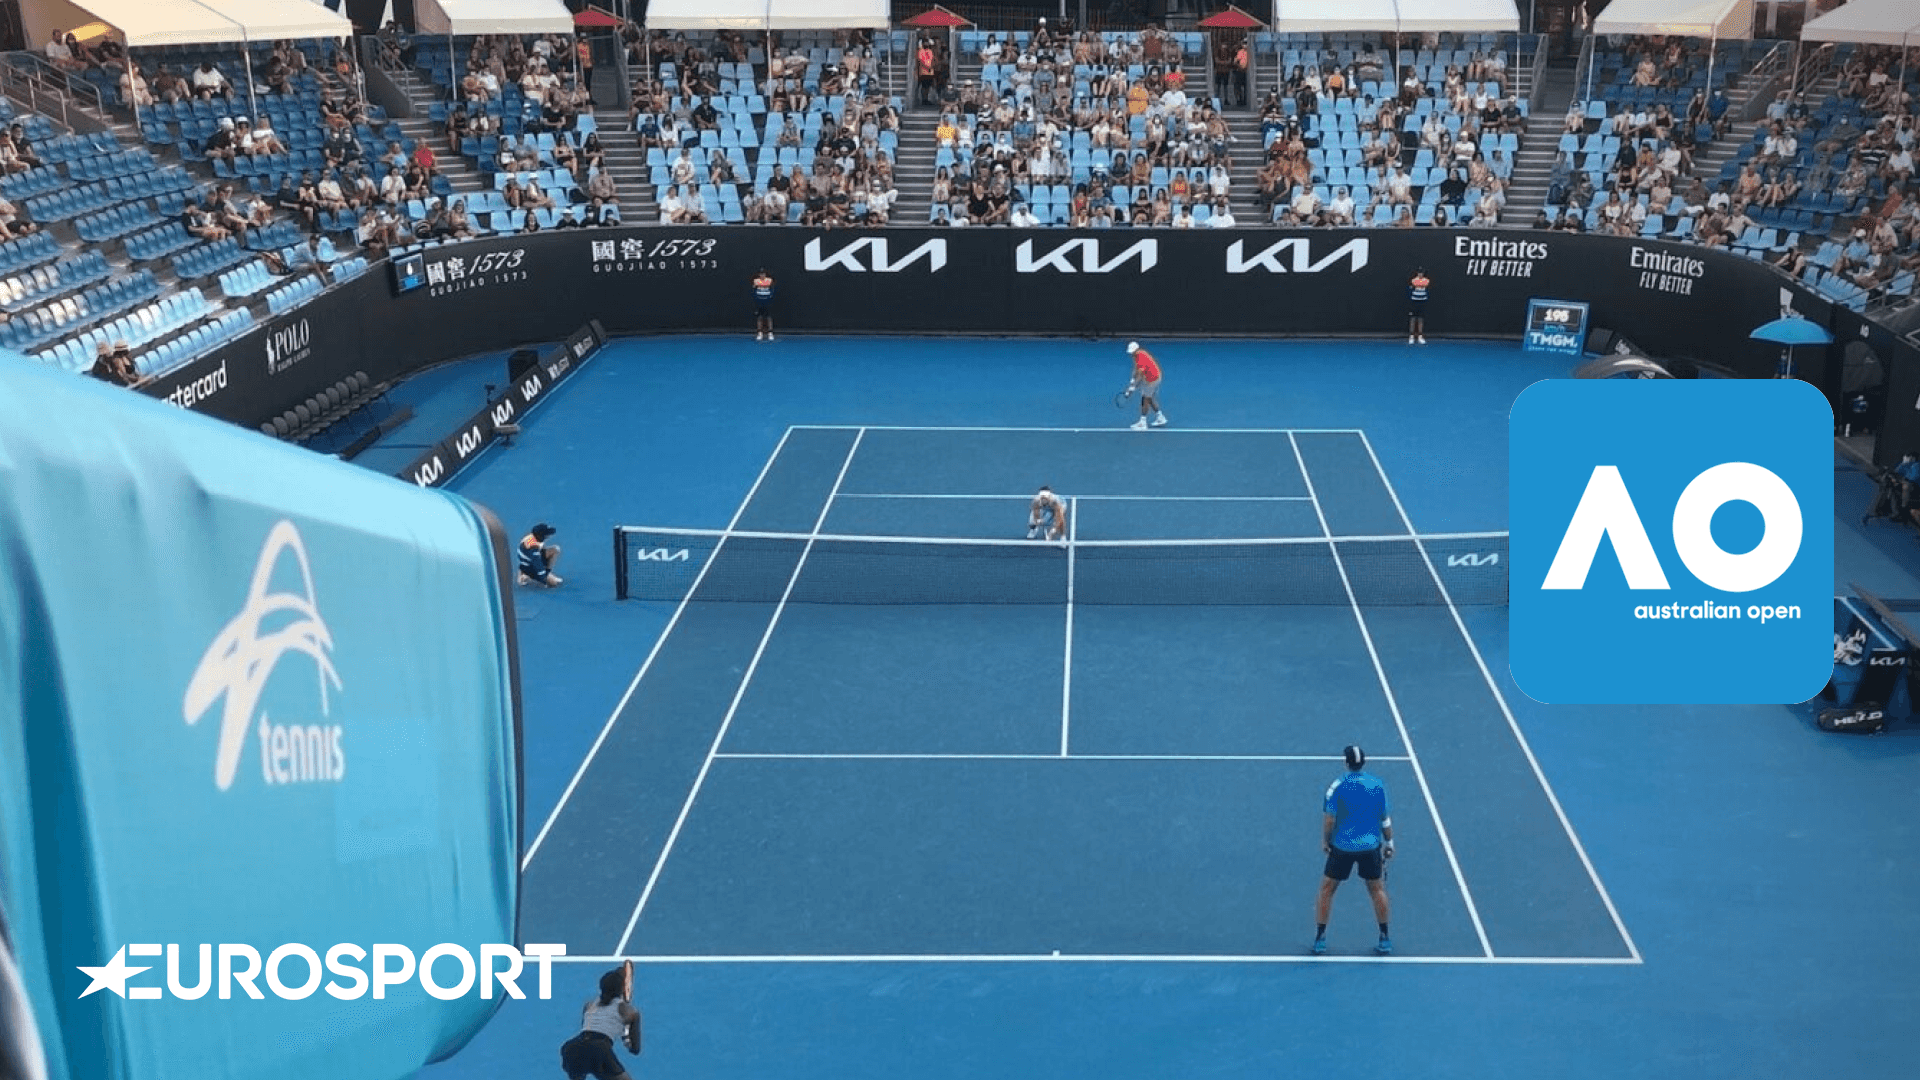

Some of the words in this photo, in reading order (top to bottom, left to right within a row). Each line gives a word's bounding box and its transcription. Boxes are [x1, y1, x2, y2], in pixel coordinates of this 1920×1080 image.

[648, 238, 717, 258] 1573
[1455, 236, 1548, 259] Emirates
[469, 248, 525, 275] 1573
[1466, 259, 1488, 276] FLY
[1489, 260, 1533, 278] BETTER
[1630, 246, 1704, 278] Emirates
[1639, 271, 1658, 289] FLY
[1658, 274, 1693, 296] BETTER
[275, 318, 310, 361] POLO
[161, 359, 228, 409] stercard
[258, 710, 346, 785] tennis
